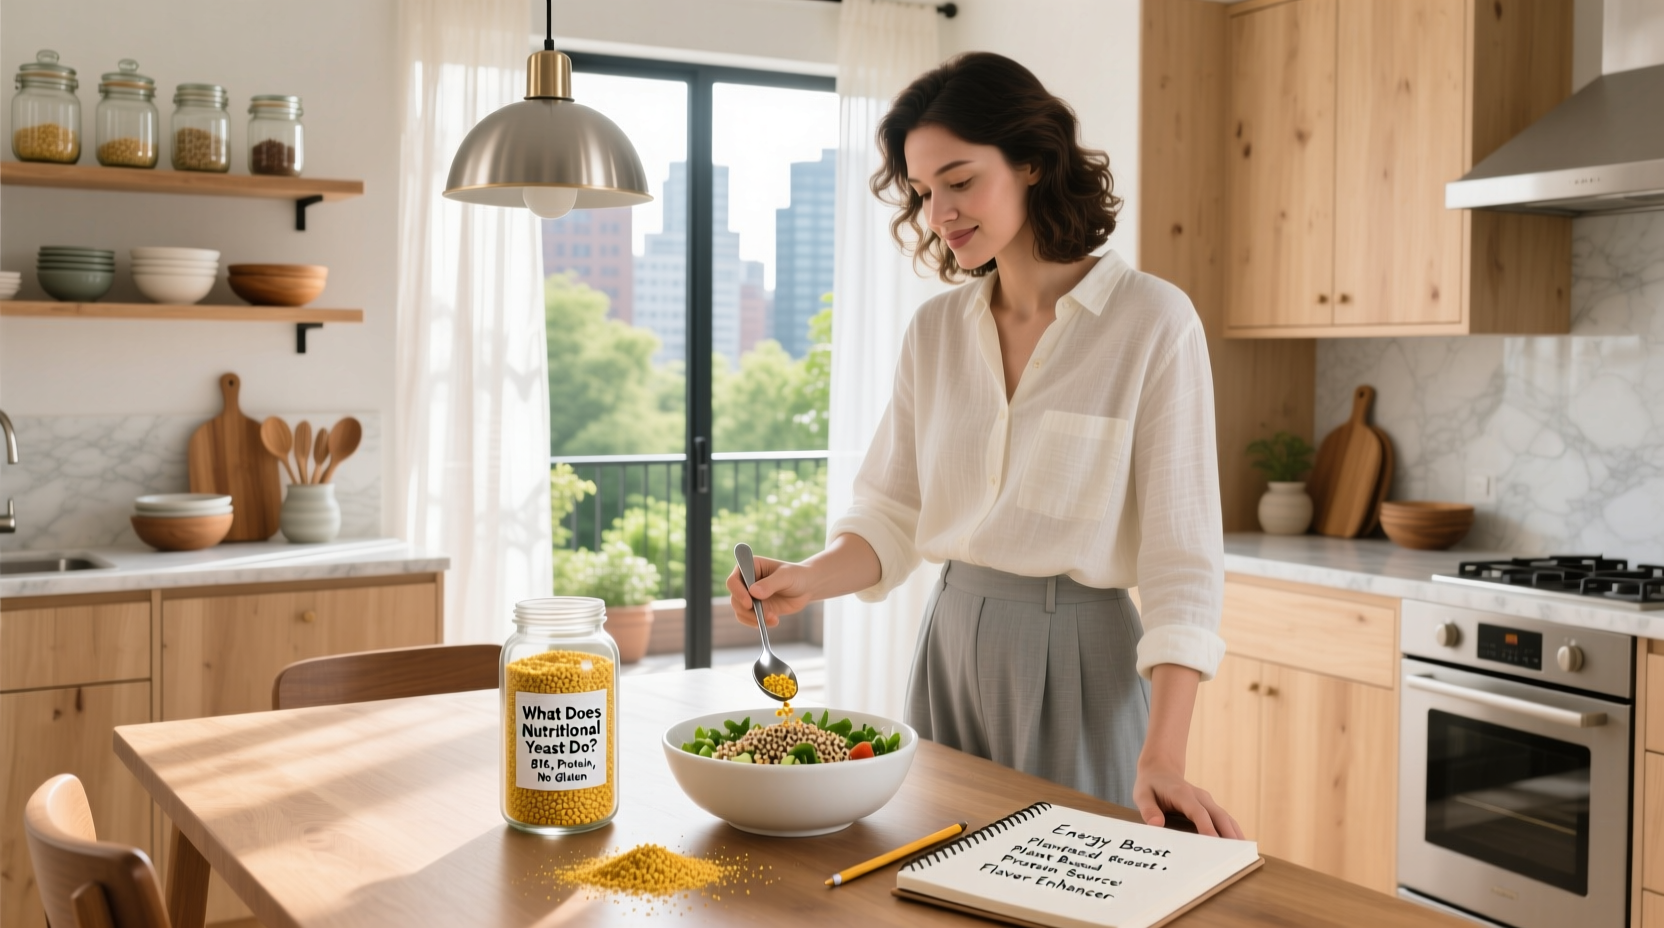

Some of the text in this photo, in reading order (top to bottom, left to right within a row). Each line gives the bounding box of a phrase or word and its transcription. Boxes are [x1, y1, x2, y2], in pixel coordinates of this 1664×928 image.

[522, 705, 602, 720] What Does
[522, 719, 601, 738] Nutritional
[525, 738, 597, 754] Yeast Do?
[537, 772, 551, 782] No
[1052, 824, 1172, 858] Energy Boost
[1035, 875, 1115, 901] Enhancer
